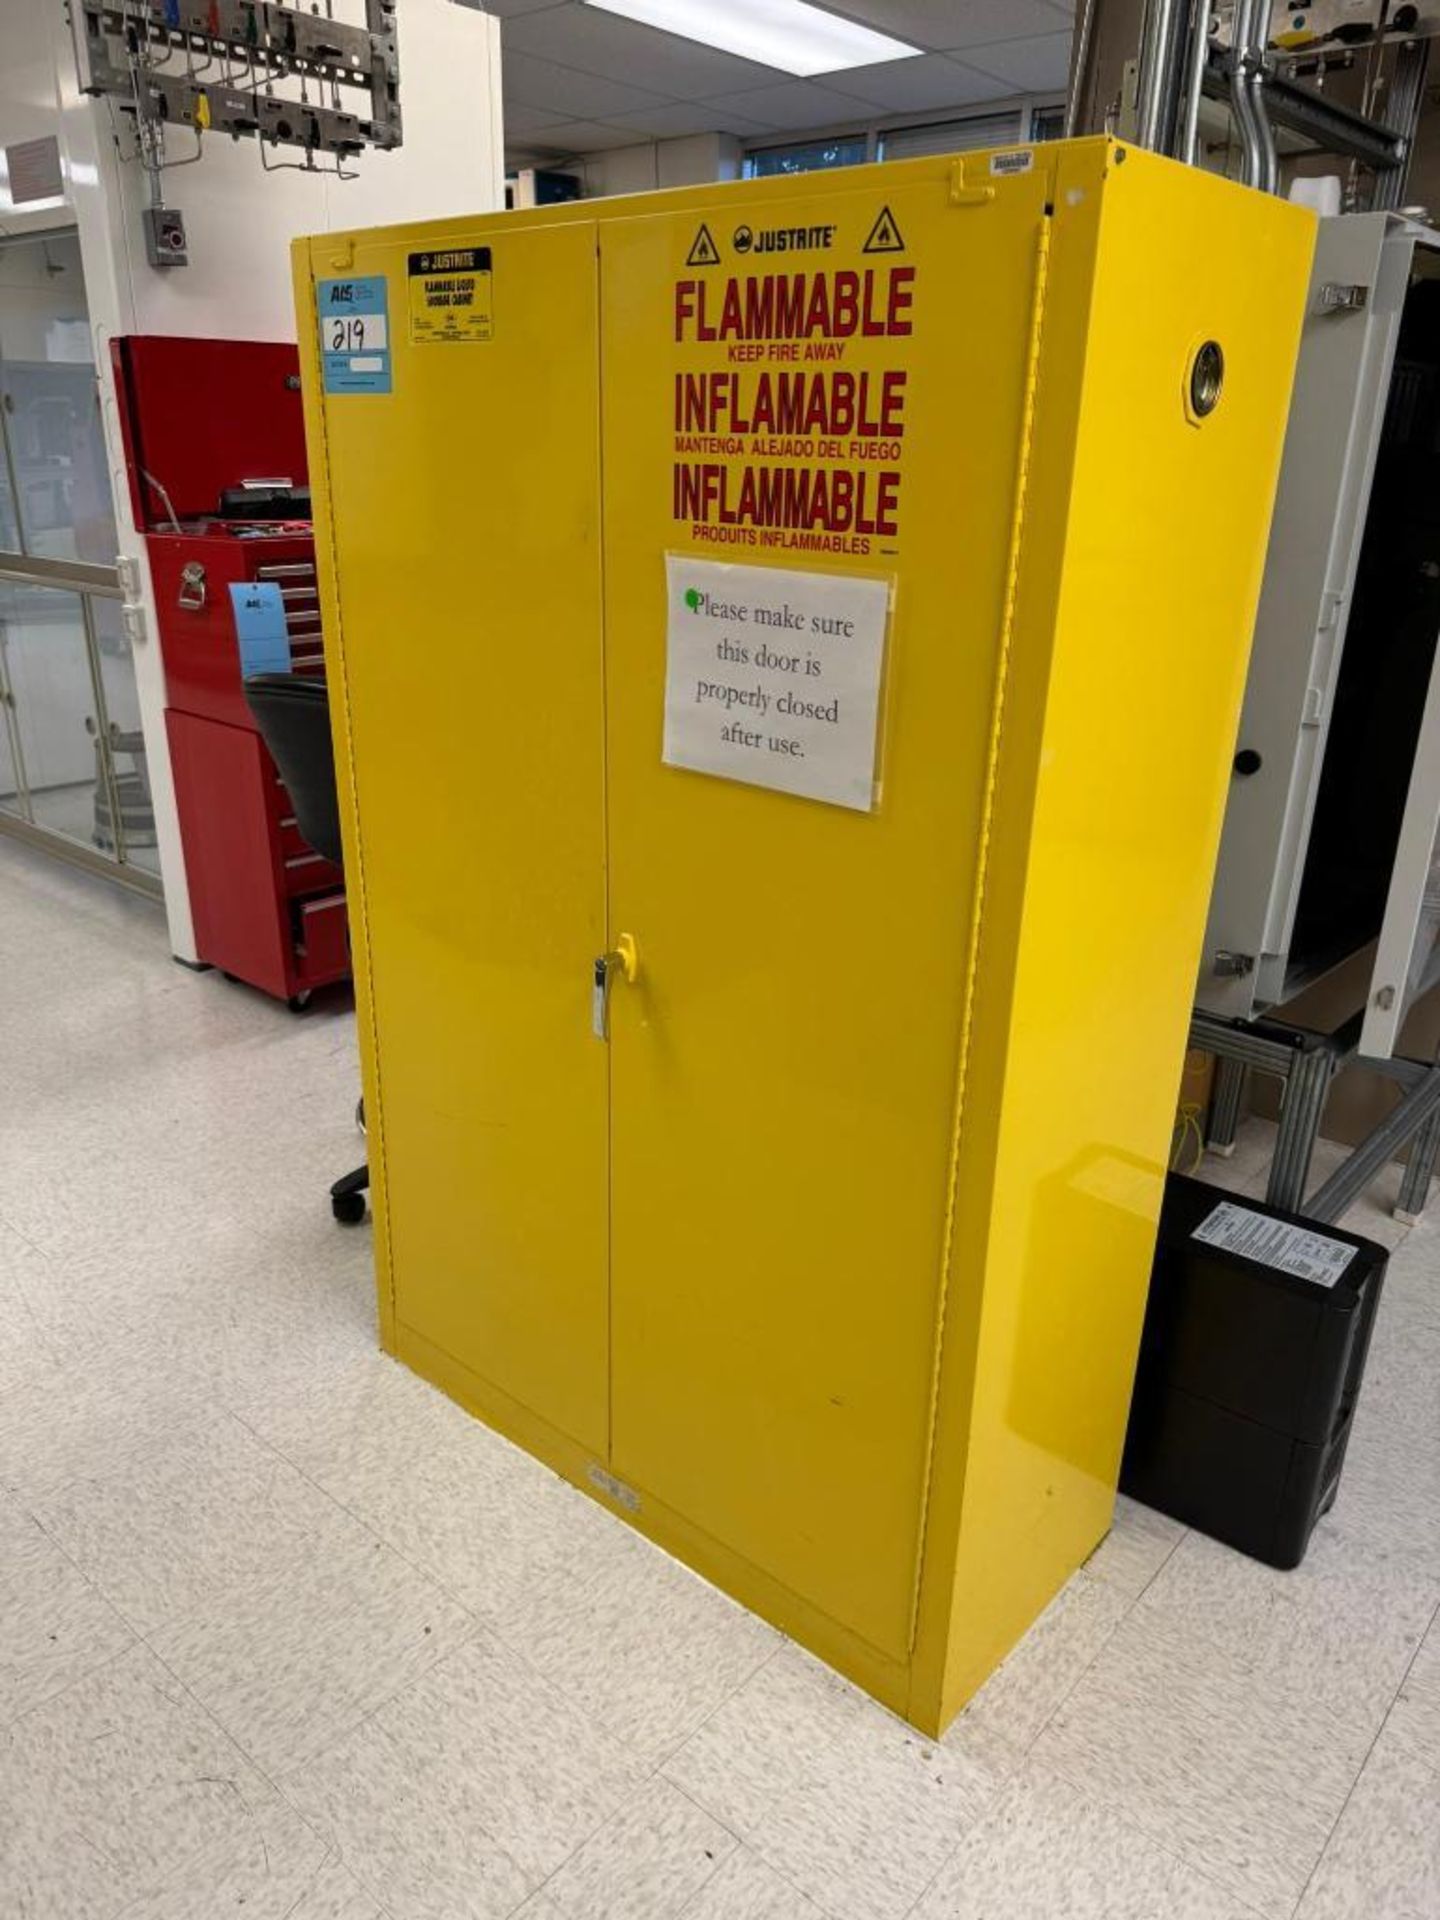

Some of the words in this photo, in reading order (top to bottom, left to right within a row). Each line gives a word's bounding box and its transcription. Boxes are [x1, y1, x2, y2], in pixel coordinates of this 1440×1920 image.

[753, 225, 833, 252] JUSTRITE
[675, 267, 915, 342] FLAMMABLE
[333, 319, 365, 352] 219
[728, 345, 764, 362] KEEP
[768, 344, 800, 361] FIRE
[804, 342, 845, 360] AWAY
[675, 371, 907, 437] INFLAMABLE
[675, 436, 744, 455] MANTENGA
[751, 439, 814, 457] ALEJADO
[817, 441, 845, 458] DEL
[850, 443, 901, 461] FUEGO
[673, 463, 901, 536] INFLAMMABLE
[692, 525, 757, 546] PRODUITS
[760, 530, 870, 555] INFLAMMABLES
[691, 592, 748, 622] Please
[753, 604, 805, 631] make
[811, 615, 855, 638] sure
[716, 638, 750, 664] this
[754, 644, 800, 673] door
[804, 652, 822, 676] is
[695, 681, 770, 716] properly
[776, 692, 838, 723] closed
[721, 722, 763, 749] after
[768, 737, 805, 758] use.
